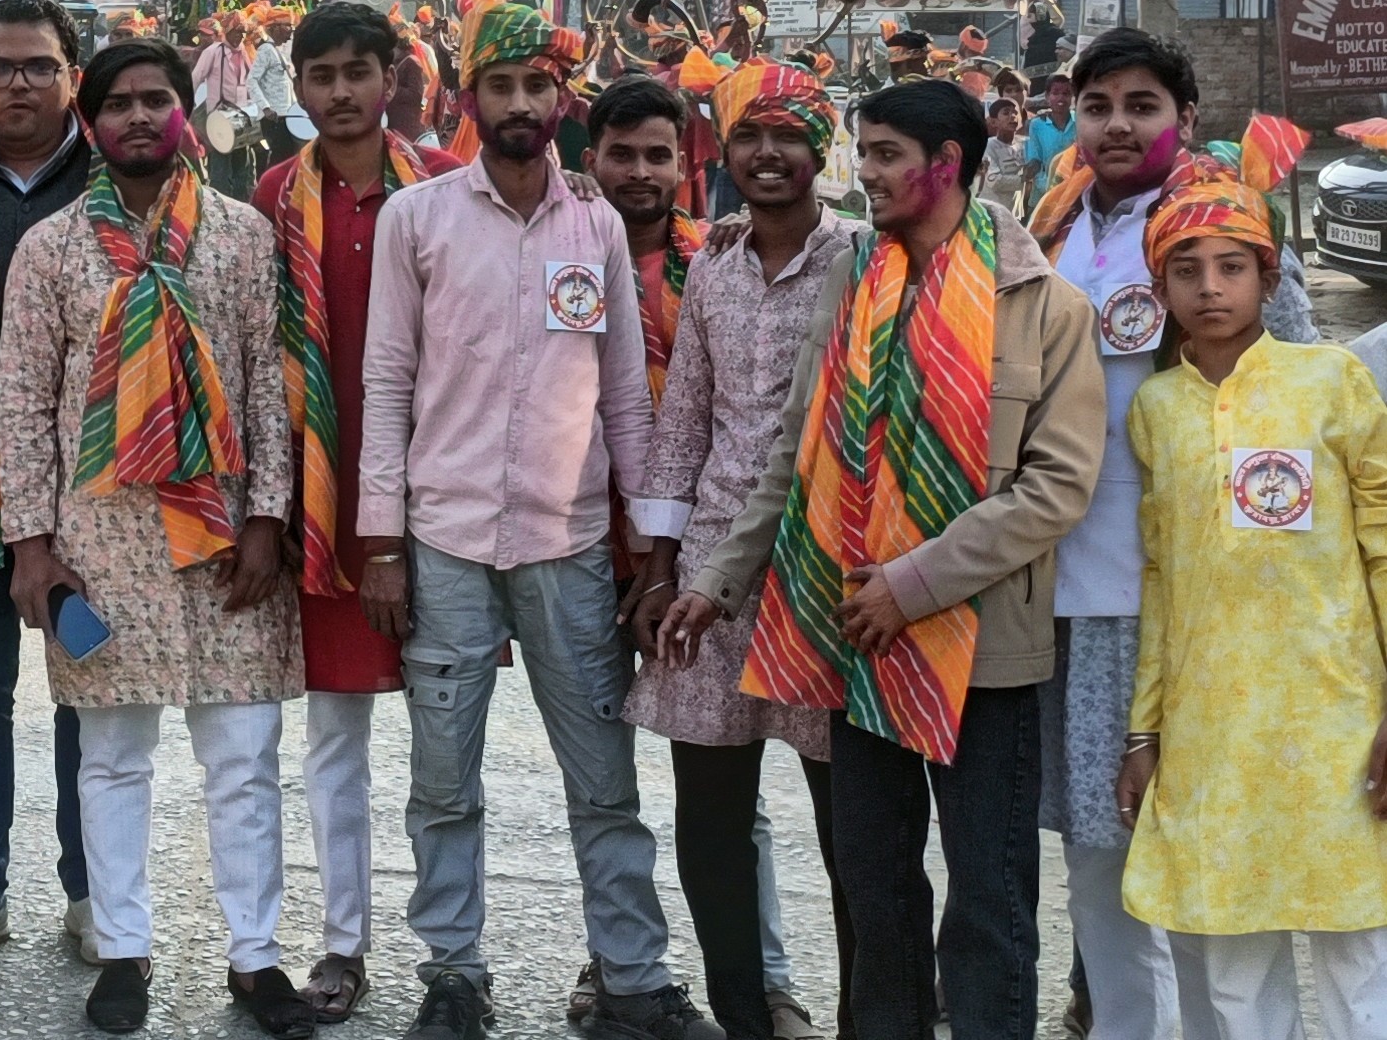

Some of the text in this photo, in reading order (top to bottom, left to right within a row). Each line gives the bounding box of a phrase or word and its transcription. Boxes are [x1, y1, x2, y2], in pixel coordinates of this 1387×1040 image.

[1335, 21, 1385, 37] MOTTO
[1289, 59, 1329, 78] Managed
[1330, 59, 1342, 77] by
